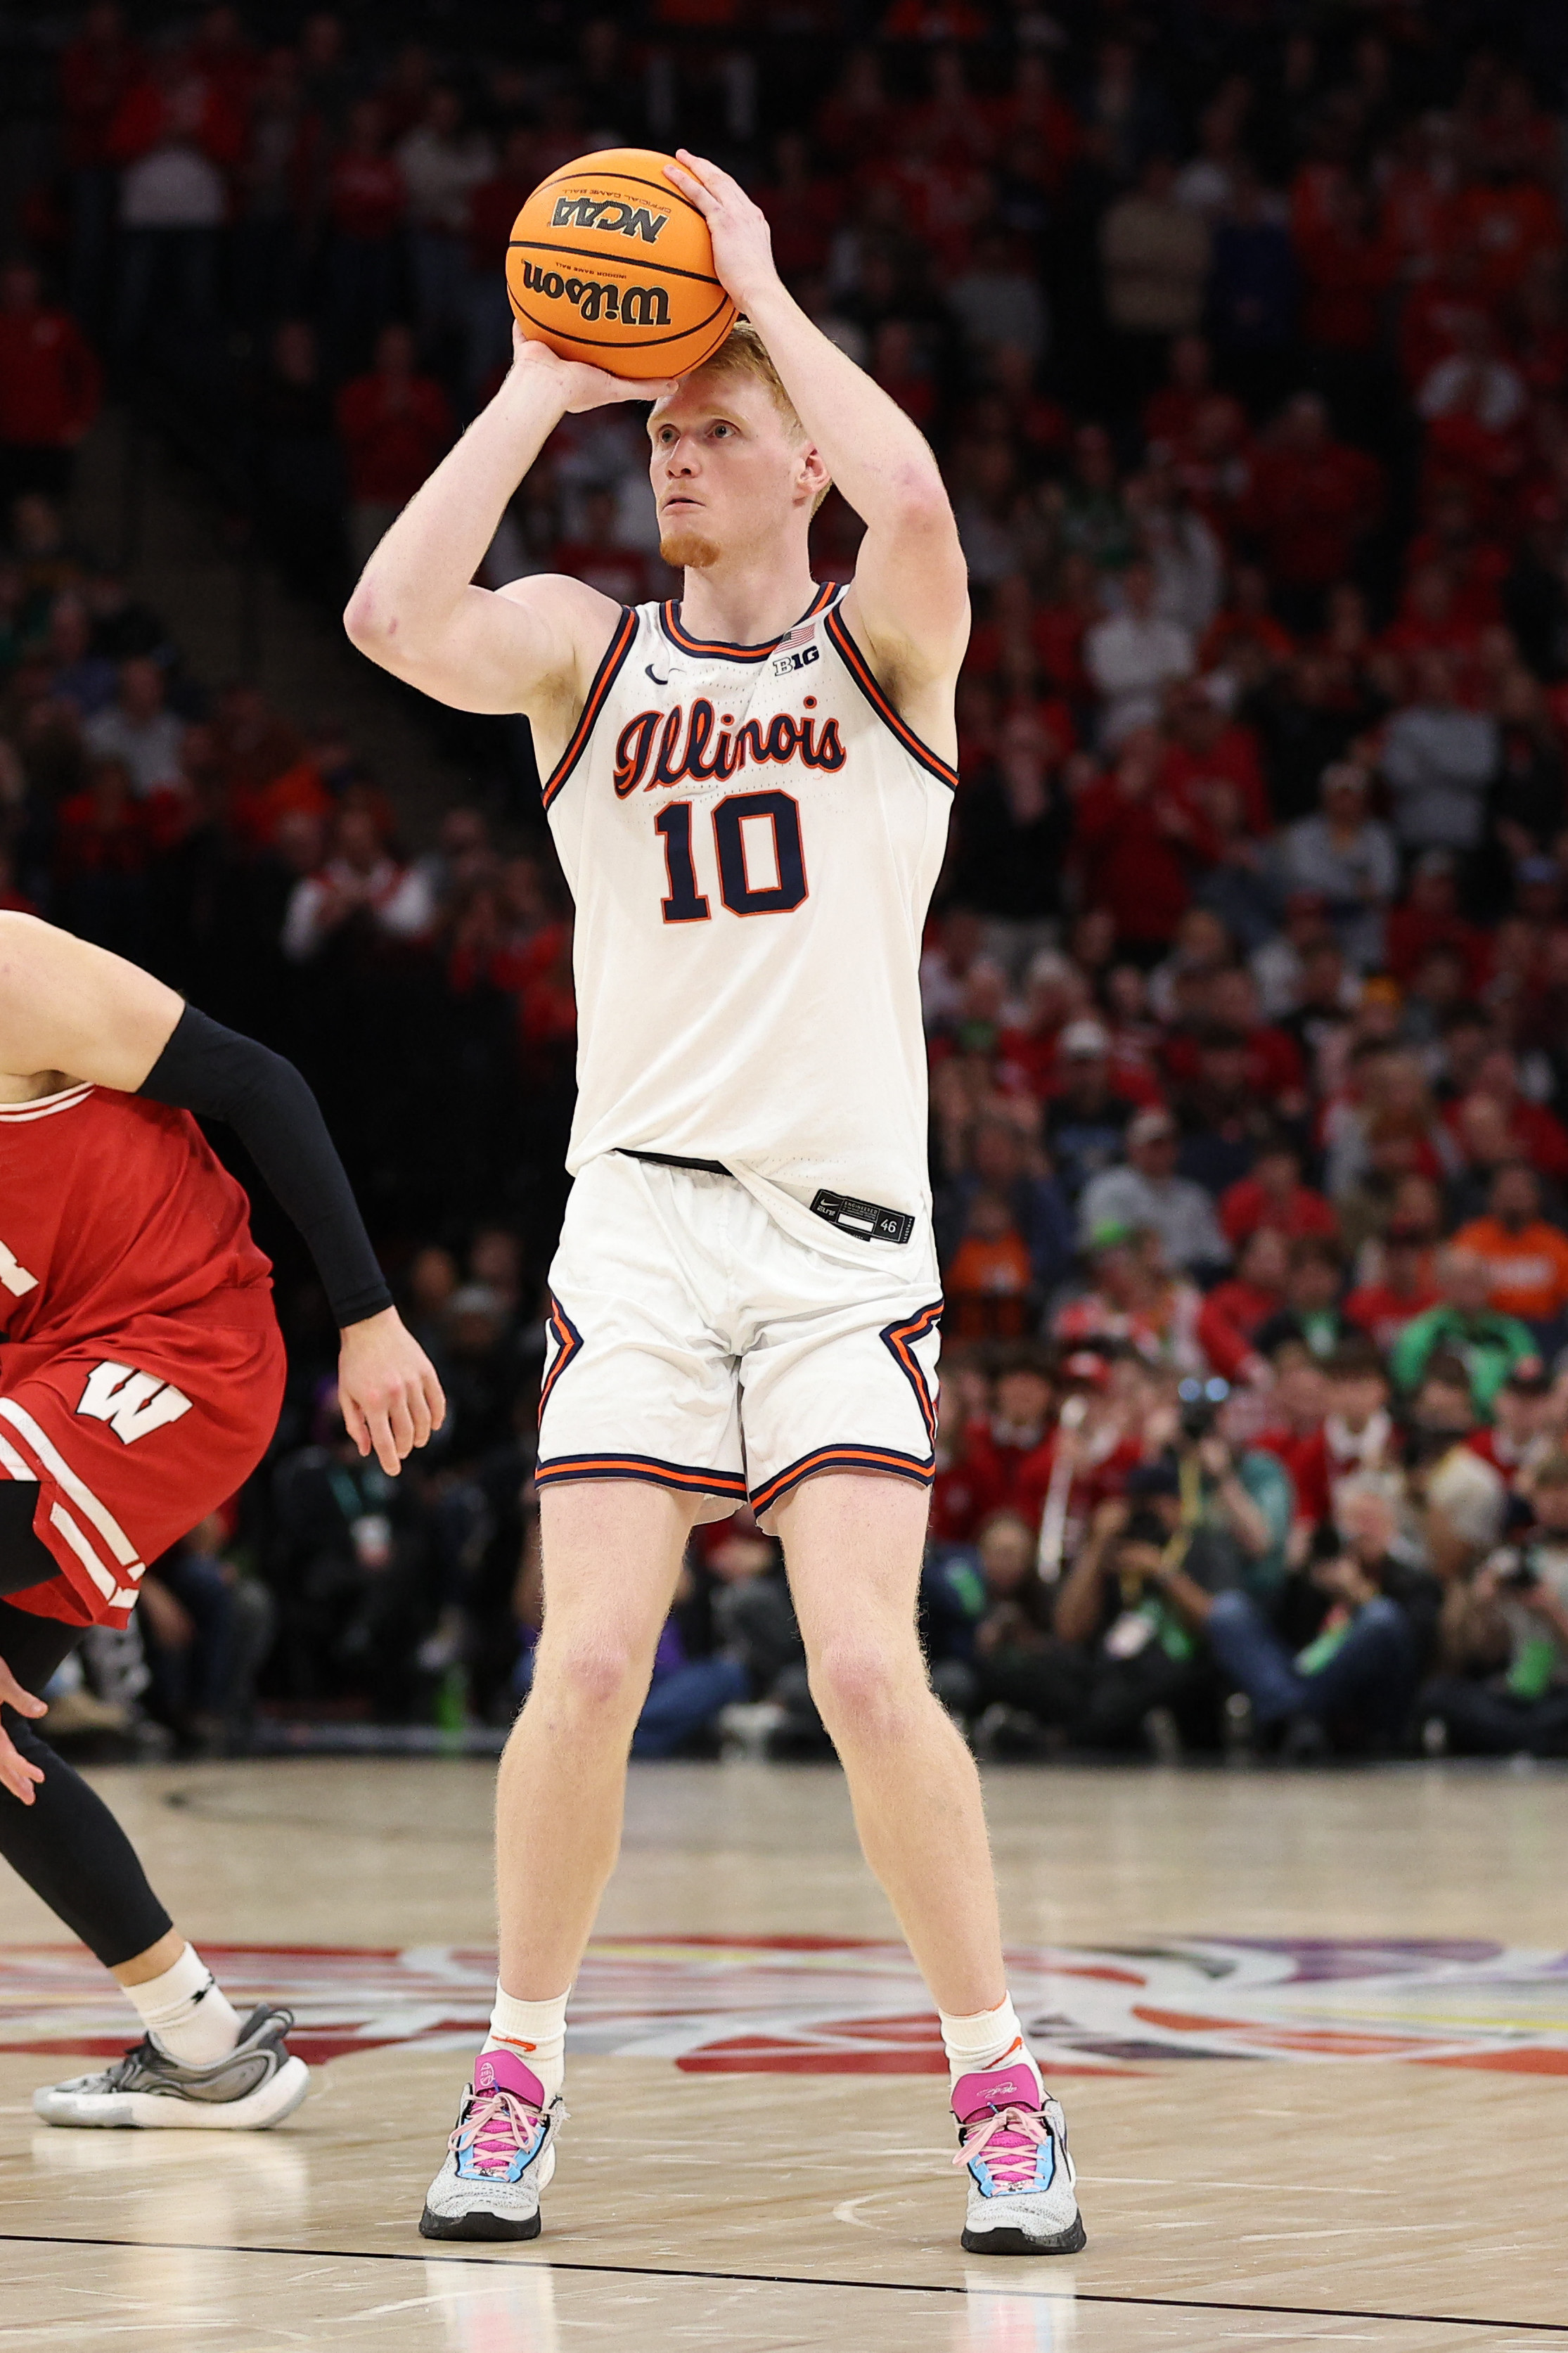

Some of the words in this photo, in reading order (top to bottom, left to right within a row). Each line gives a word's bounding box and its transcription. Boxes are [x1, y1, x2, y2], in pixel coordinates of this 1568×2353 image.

[551, 196, 671, 244] NCAA
[624, 195, 671, 213] OFFICIAL
[523, 261, 671, 326] Wilson
[613, 695, 847, 800] Illinois
[654, 789, 809, 924] 10
[880, 1219, 897, 1233] 46
[75, 1359, 193, 1445] W
